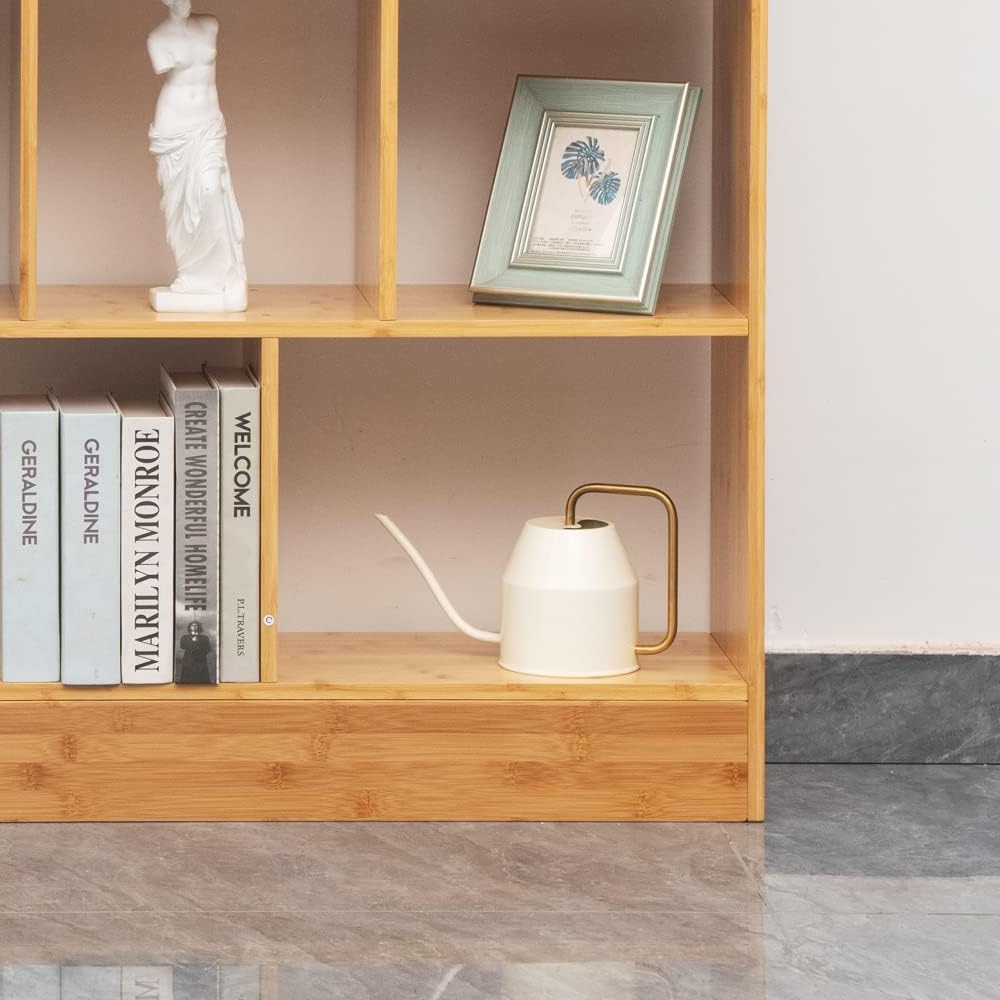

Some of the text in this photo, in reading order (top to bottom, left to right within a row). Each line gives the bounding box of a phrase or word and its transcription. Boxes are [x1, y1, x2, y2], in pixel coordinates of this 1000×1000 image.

[21, 439, 38, 546] GERALDINE
[83, 438, 100, 545] GERALDINE
[183, 401, 208, 611] CREATE WONDERFUL HOMELIFE
[233, 411, 252, 518] WELCOME
[133, 428, 160, 672] MARILYN MONROE
